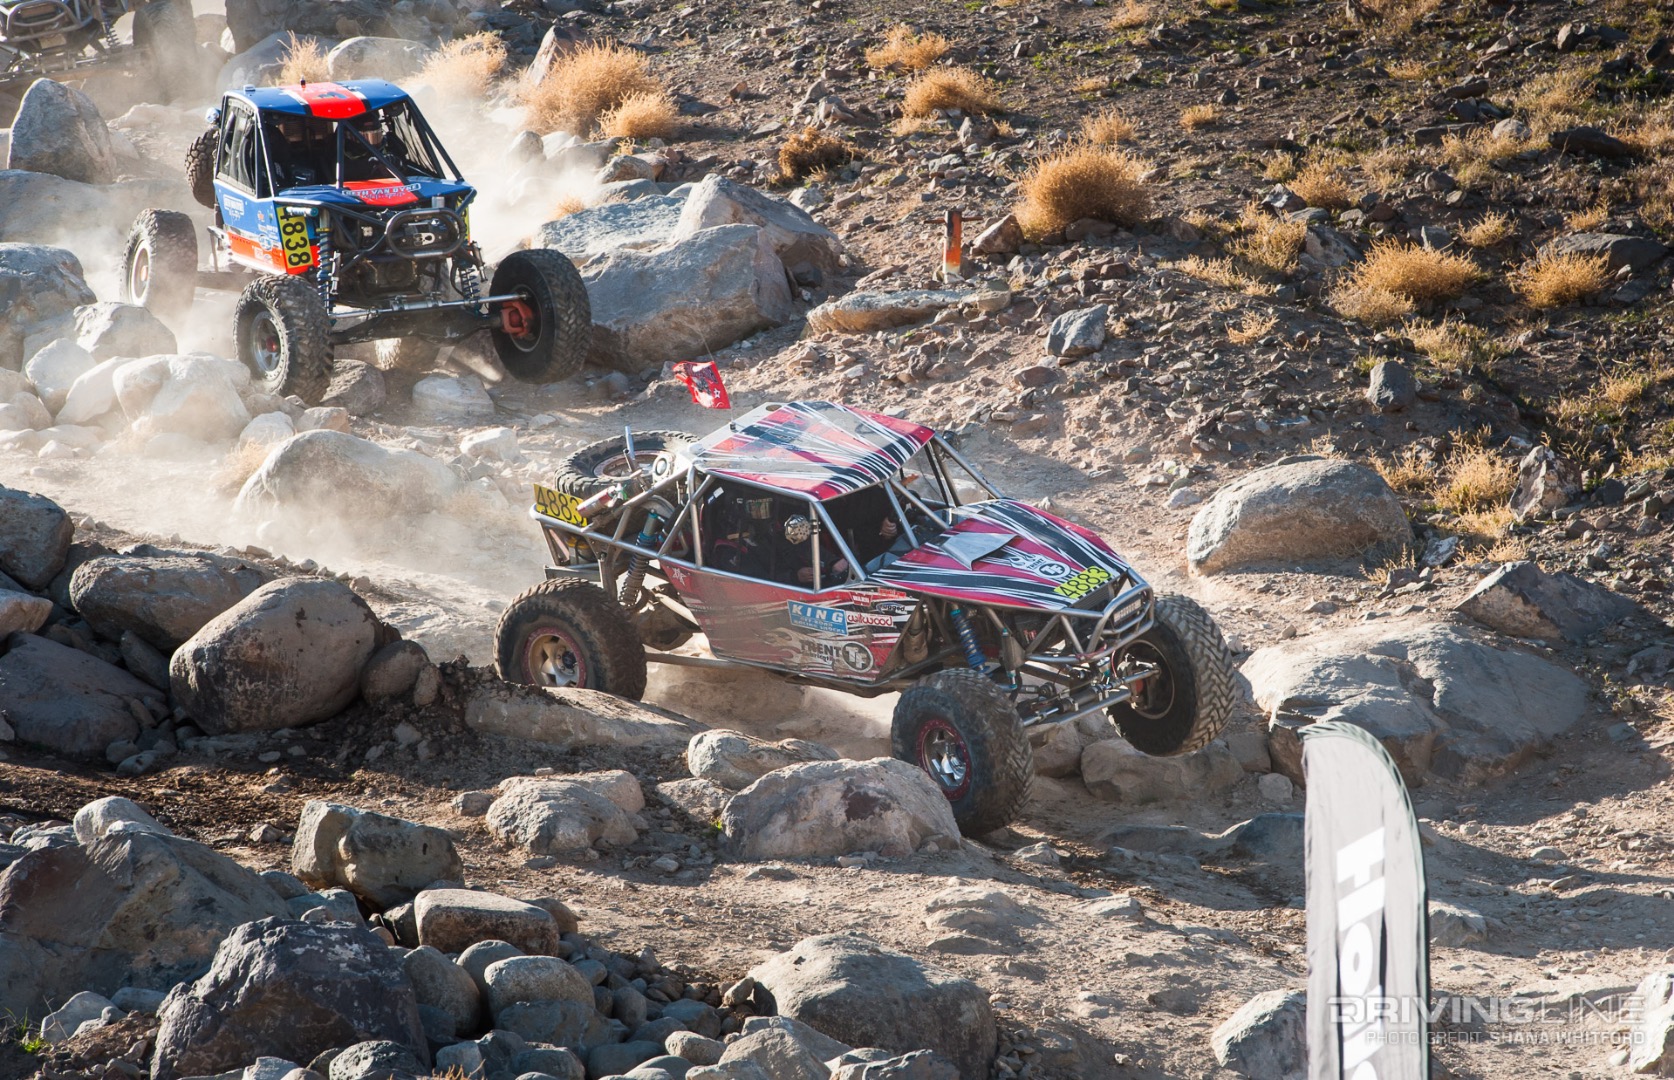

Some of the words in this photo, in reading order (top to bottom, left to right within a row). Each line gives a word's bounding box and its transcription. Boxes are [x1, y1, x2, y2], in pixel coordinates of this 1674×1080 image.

[370, 187, 391, 196] VAN
[1058, 566, 1111, 597] 4883
[791, 604, 844, 624] KING
[847, 613, 893, 627] wilwood
[799, 639, 842, 658] TRENT
